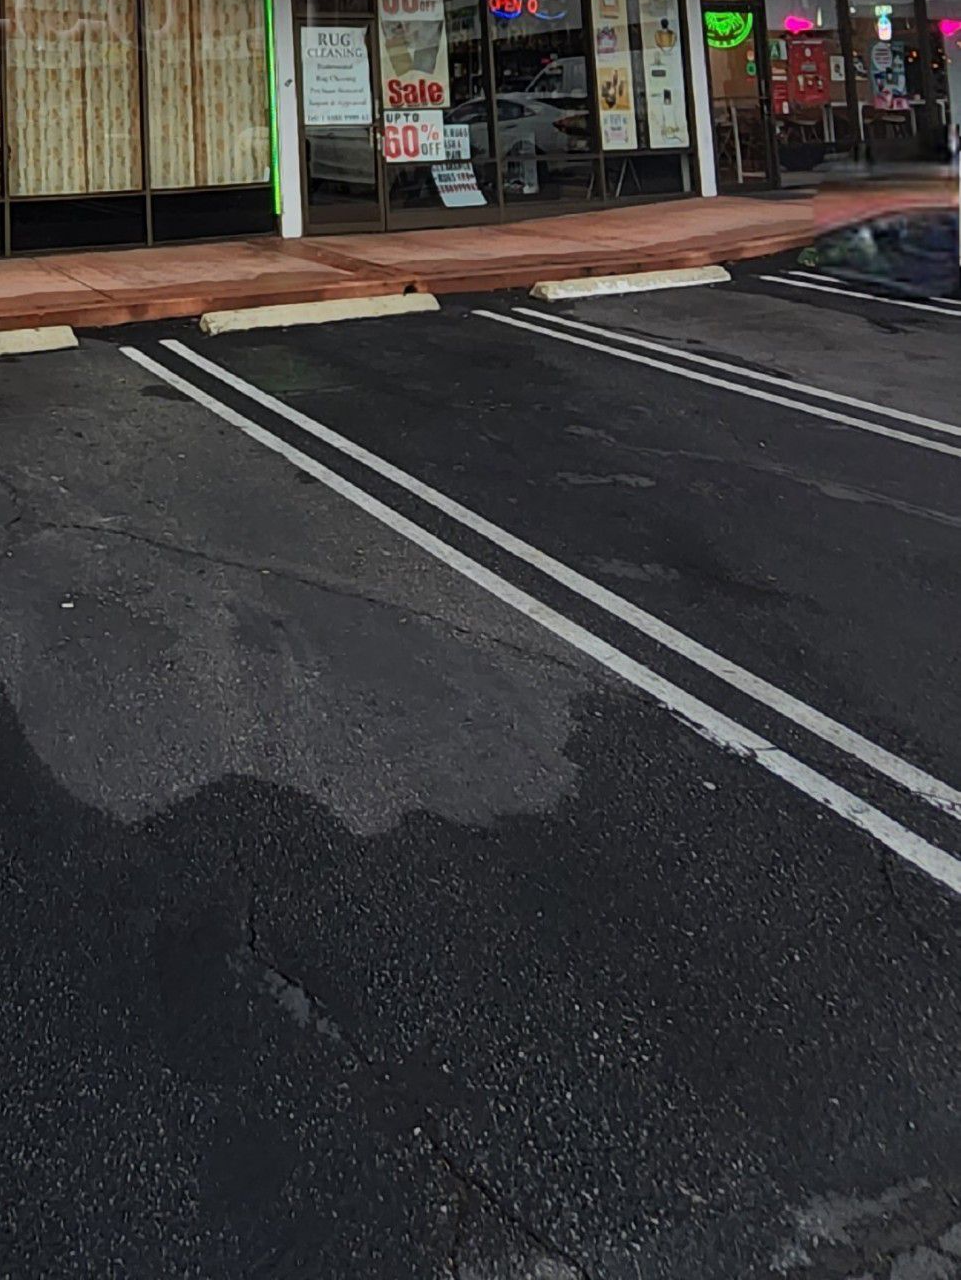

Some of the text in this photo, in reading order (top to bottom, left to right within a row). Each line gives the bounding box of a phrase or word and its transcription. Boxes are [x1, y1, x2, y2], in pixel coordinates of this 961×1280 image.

[318, 32, 351, 47] RUG
[307, 48, 363, 58] CLEANING
[388, 79, 444, 106] Sale
[384, 124, 439, 158] 60%
[421, 142, 442, 155] OFF
